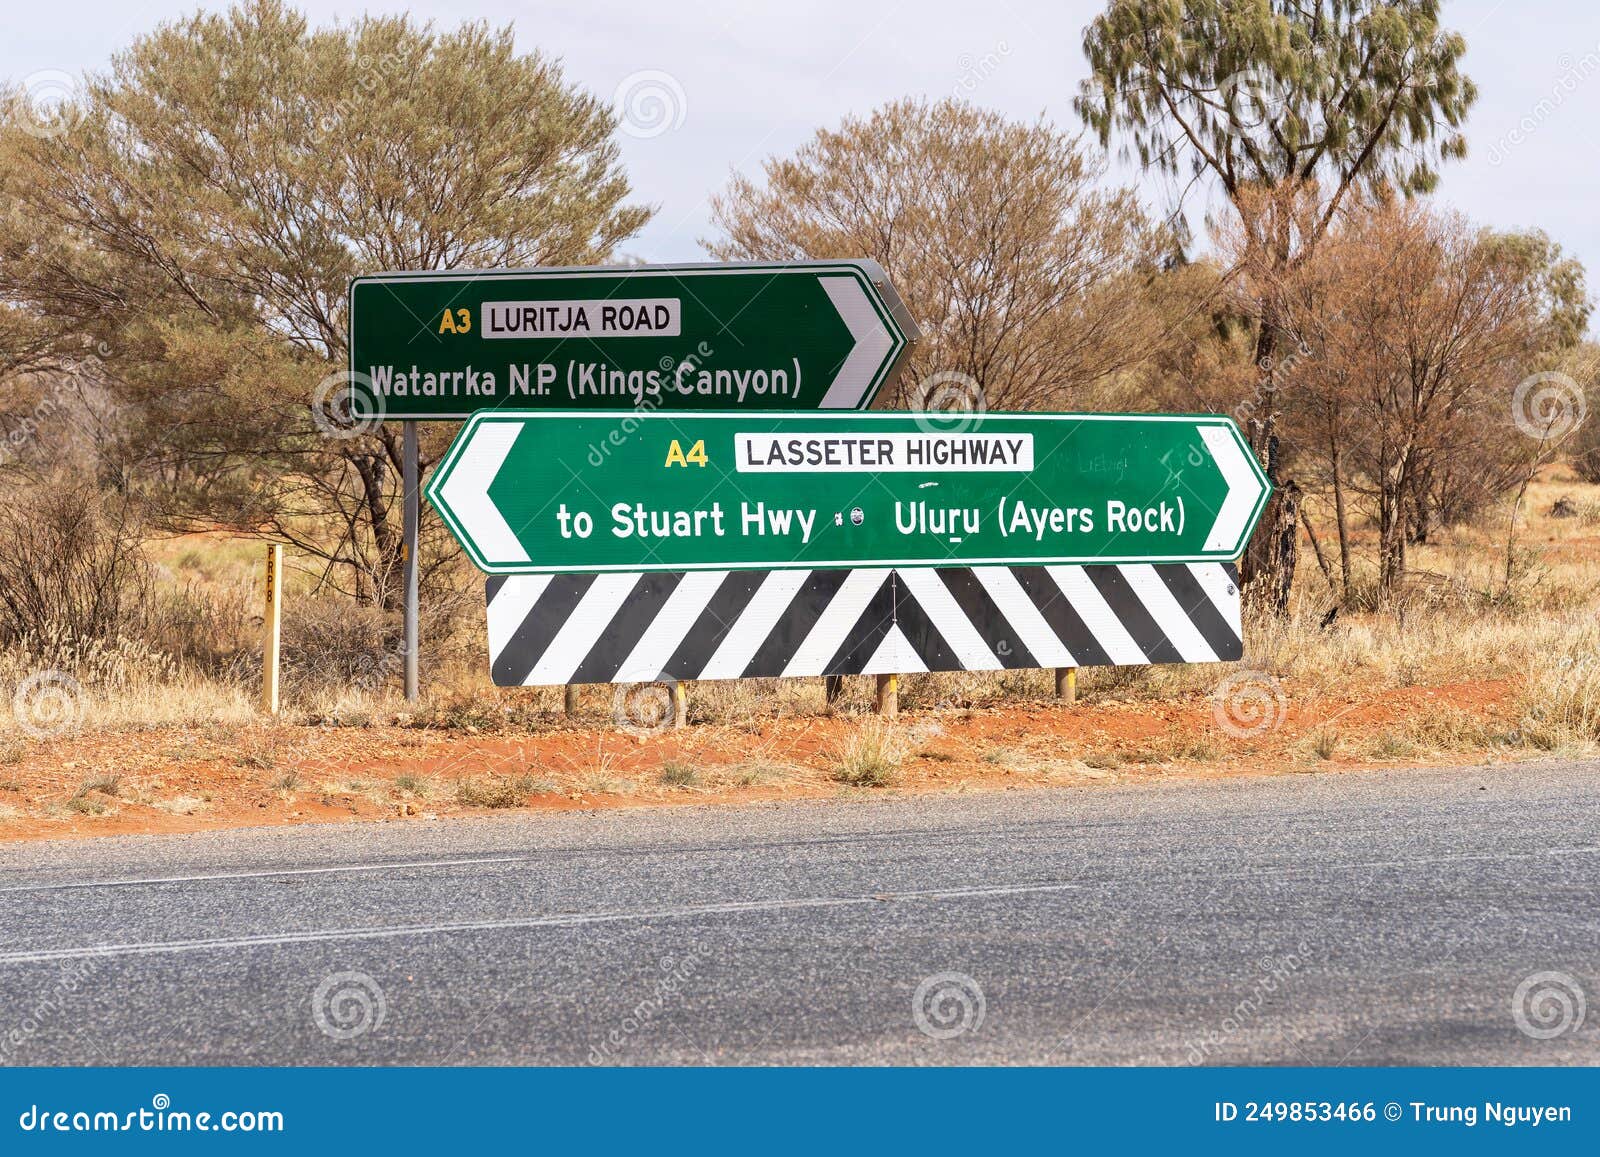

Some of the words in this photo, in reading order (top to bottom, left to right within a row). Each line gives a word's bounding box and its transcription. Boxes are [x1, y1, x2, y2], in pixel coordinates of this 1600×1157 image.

[438, 308, 471, 334] A3
[490, 306, 590, 333] LURITJA
[601, 304, 671, 331] ROAD
[370, 364, 496, 398] Watarrka
[567, 360, 661, 405] (Kings
[676, 358, 802, 402] Canyon)
[664, 440, 708, 467] A4
[747, 438, 894, 466] LASSETER
[906, 439, 1024, 465] HIGHWAY
[556, 504, 593, 539] to
[611, 502, 725, 538] Stuart
[741, 502, 817, 543] Hwy
[999, 497, 1094, 541] (Ayers
[1107, 497, 1185, 535] Rock)
